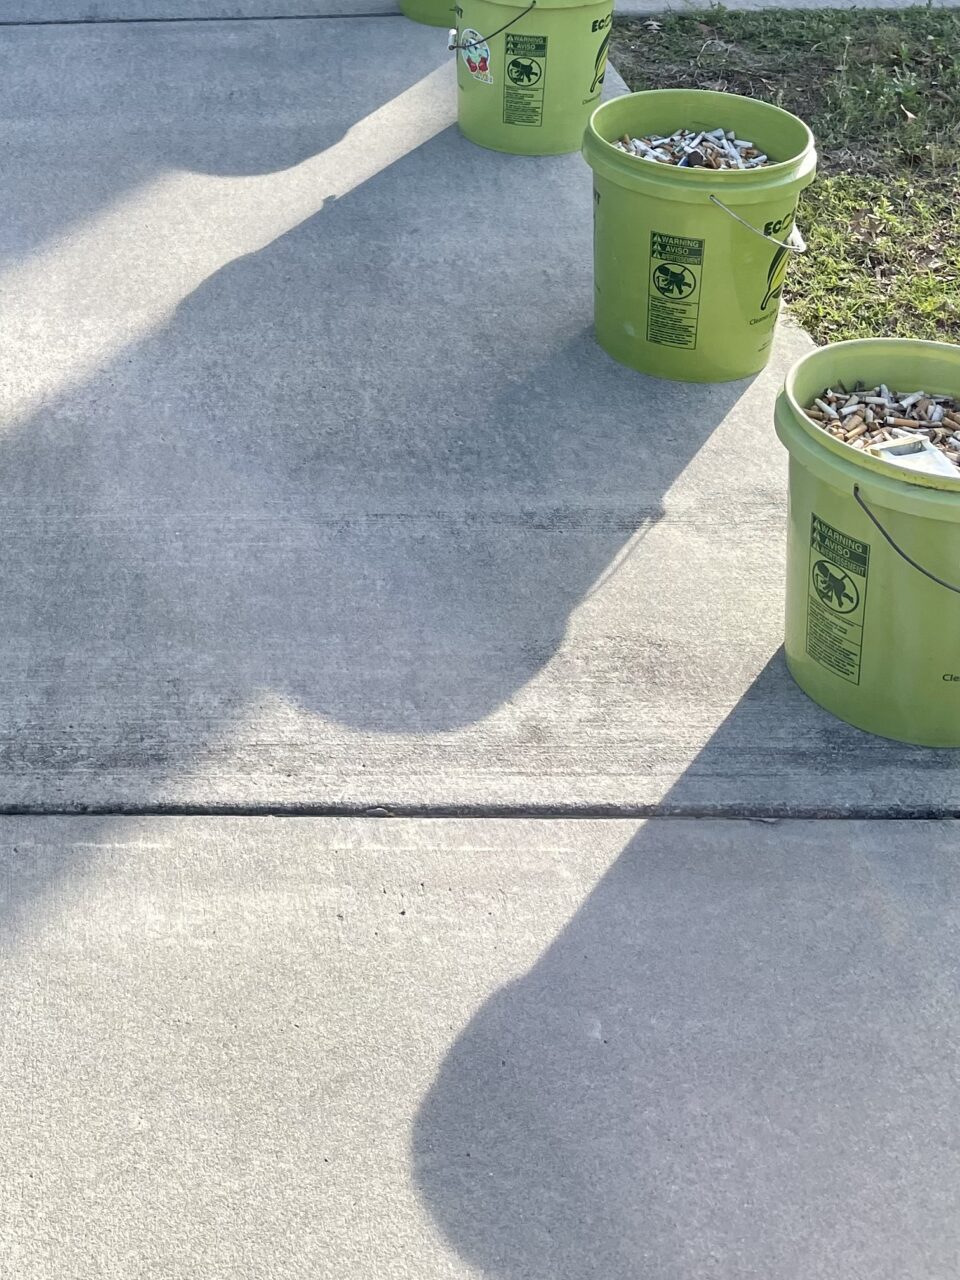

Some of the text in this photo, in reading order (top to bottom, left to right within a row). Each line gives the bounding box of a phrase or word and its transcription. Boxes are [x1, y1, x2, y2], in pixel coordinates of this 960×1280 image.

[661, 235, 699, 248] WARNING
[665, 245, 689, 255] AVISO
[821, 523, 863, 553] WARNING
[824, 538, 850, 558] AVISO
